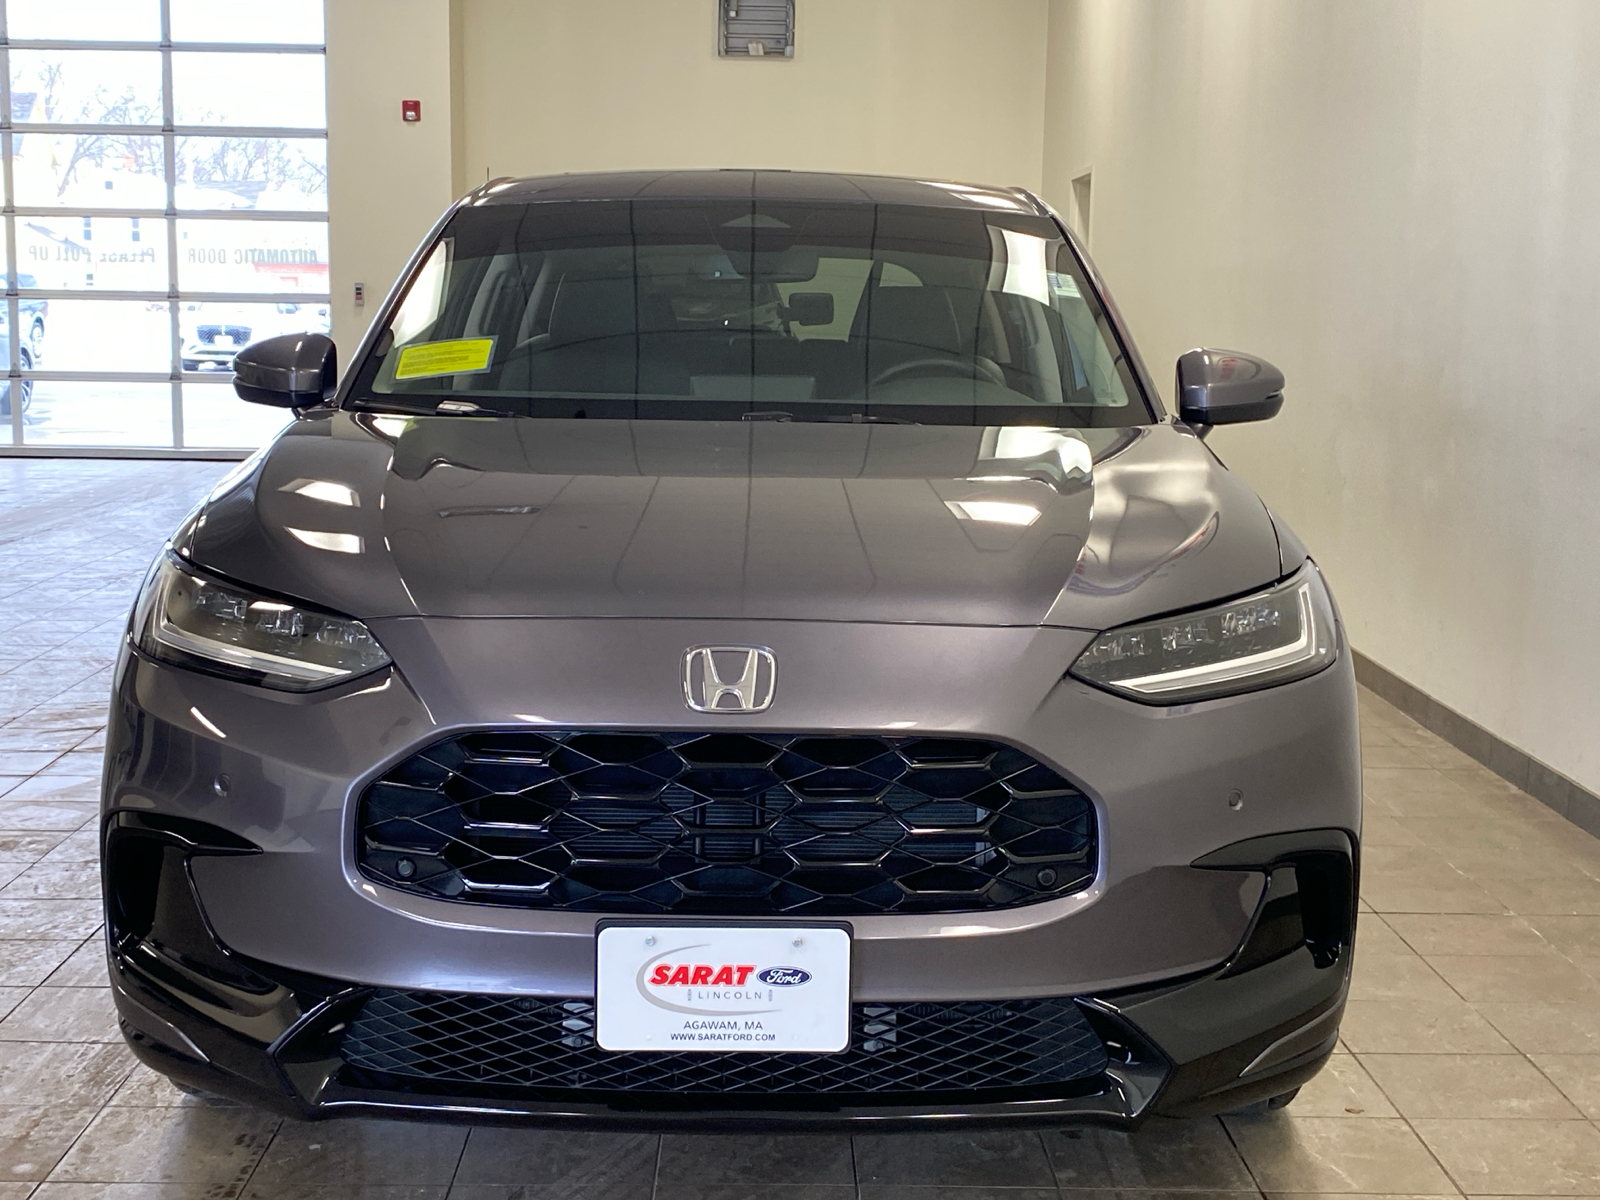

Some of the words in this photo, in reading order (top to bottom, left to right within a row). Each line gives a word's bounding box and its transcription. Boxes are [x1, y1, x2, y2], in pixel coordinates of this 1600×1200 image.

[648, 963, 756, 987] SARAT
[766, 969, 802, 984] Ford
[698, 991, 763, 1000] LINCOLN
[683, 1020, 741, 1032] AGAWAM,
[744, 1020, 764, 1030] MA
[670, 1033, 776, 1042] WWW.SARATFORD.COM
